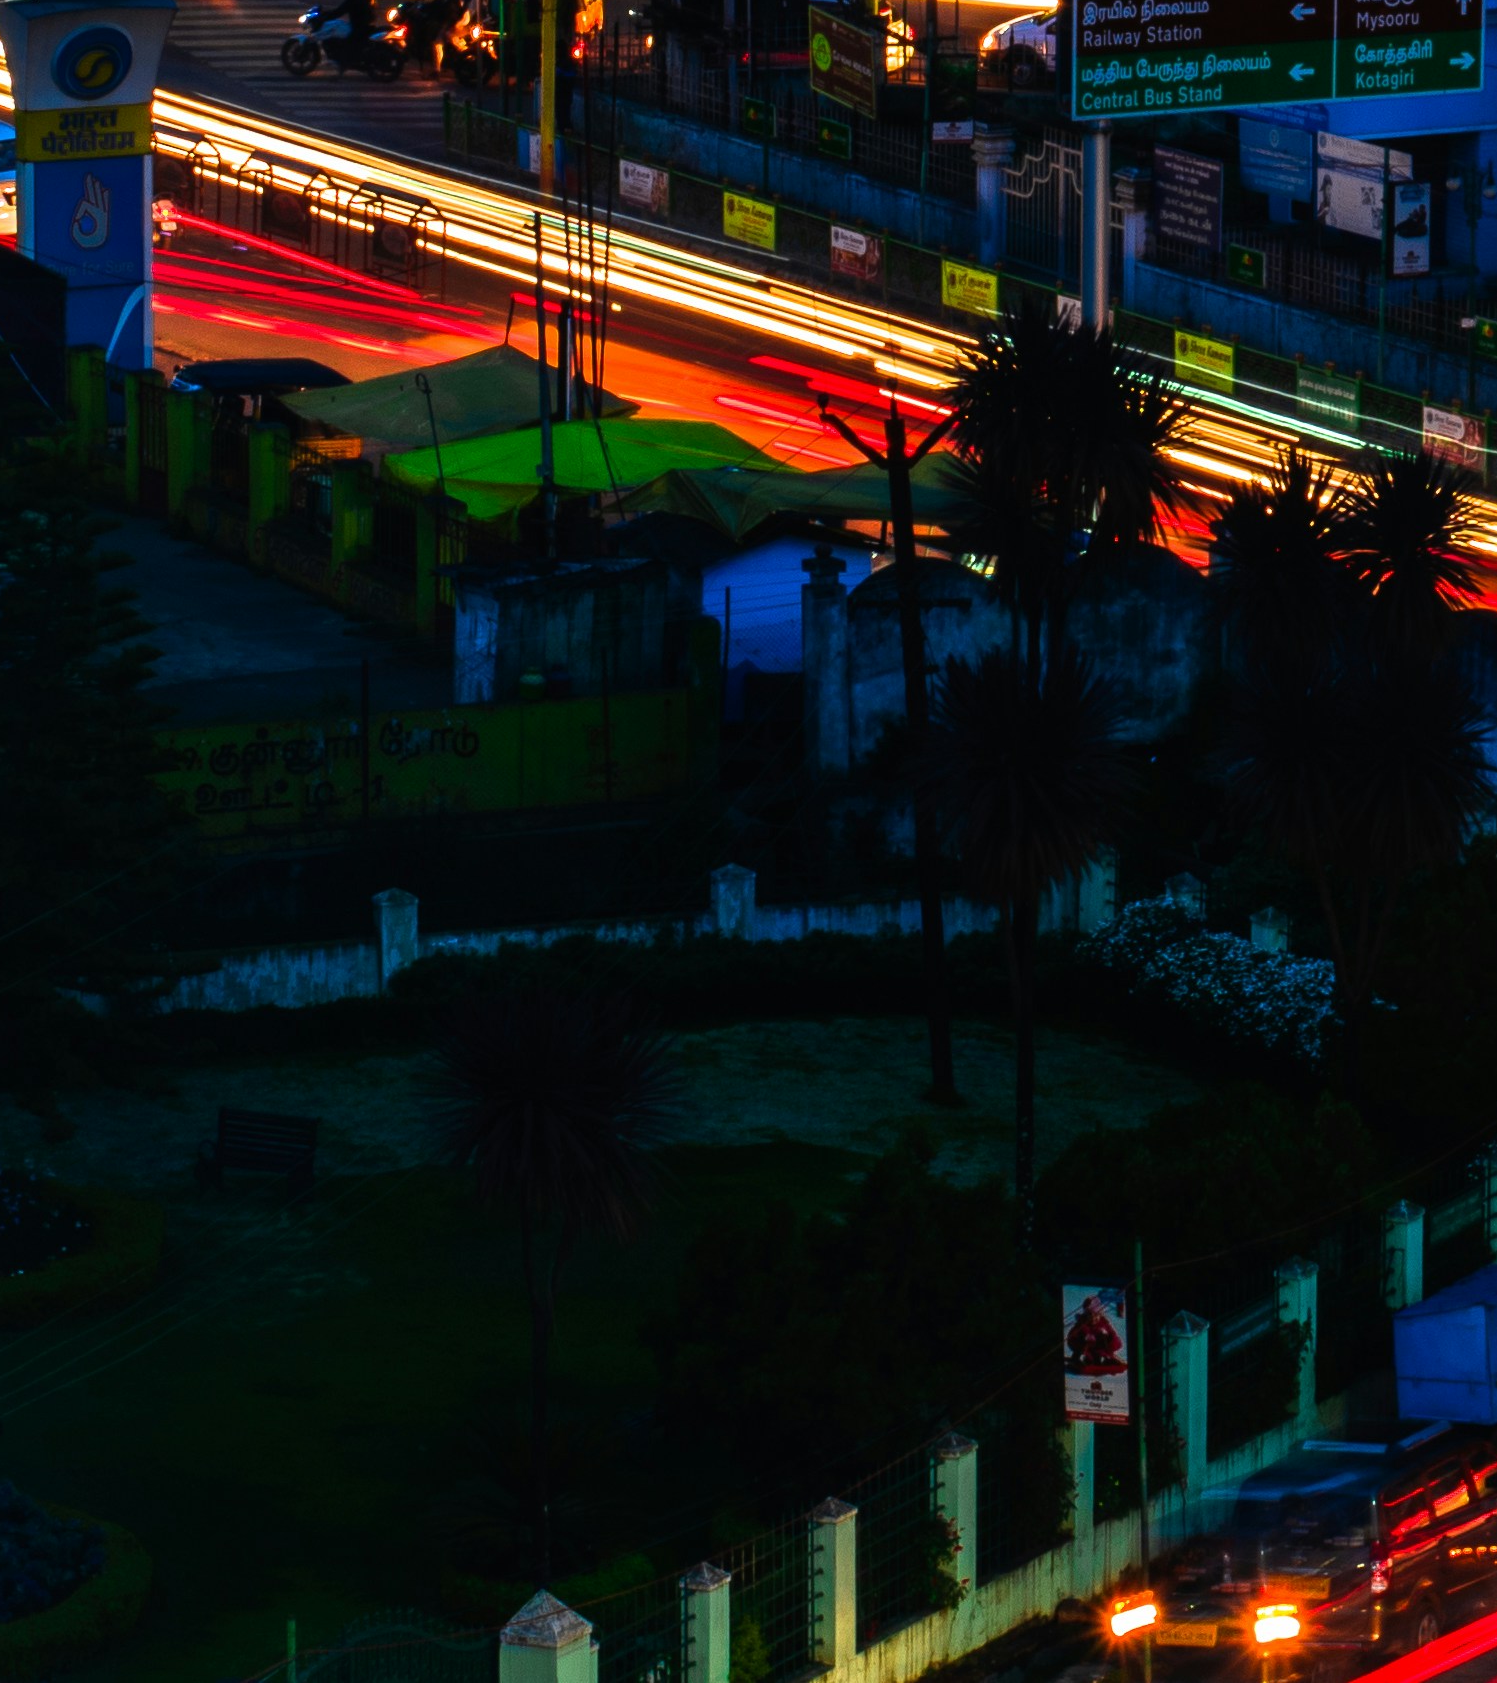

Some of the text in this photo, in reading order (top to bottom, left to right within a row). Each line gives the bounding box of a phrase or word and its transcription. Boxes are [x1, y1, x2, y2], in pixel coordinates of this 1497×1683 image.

[1082, 0, 1138, 25] இரயில்
[1356, 10, 1420, 31] Mysooru
[1082, 24, 1203, 49] Railway Station
[1354, 38, 1433, 64] கோத்தகிரி
[1081, 51, 1271, 83] மத்திய பேருந்து நிலையம்
[1355, 70, 1415, 91] Kotagiri
[1081, 84, 1223, 111] Central Bus Stand
[59, 109, 118, 131] भारत
[41, 129, 136, 156] पेट्रोलियम
